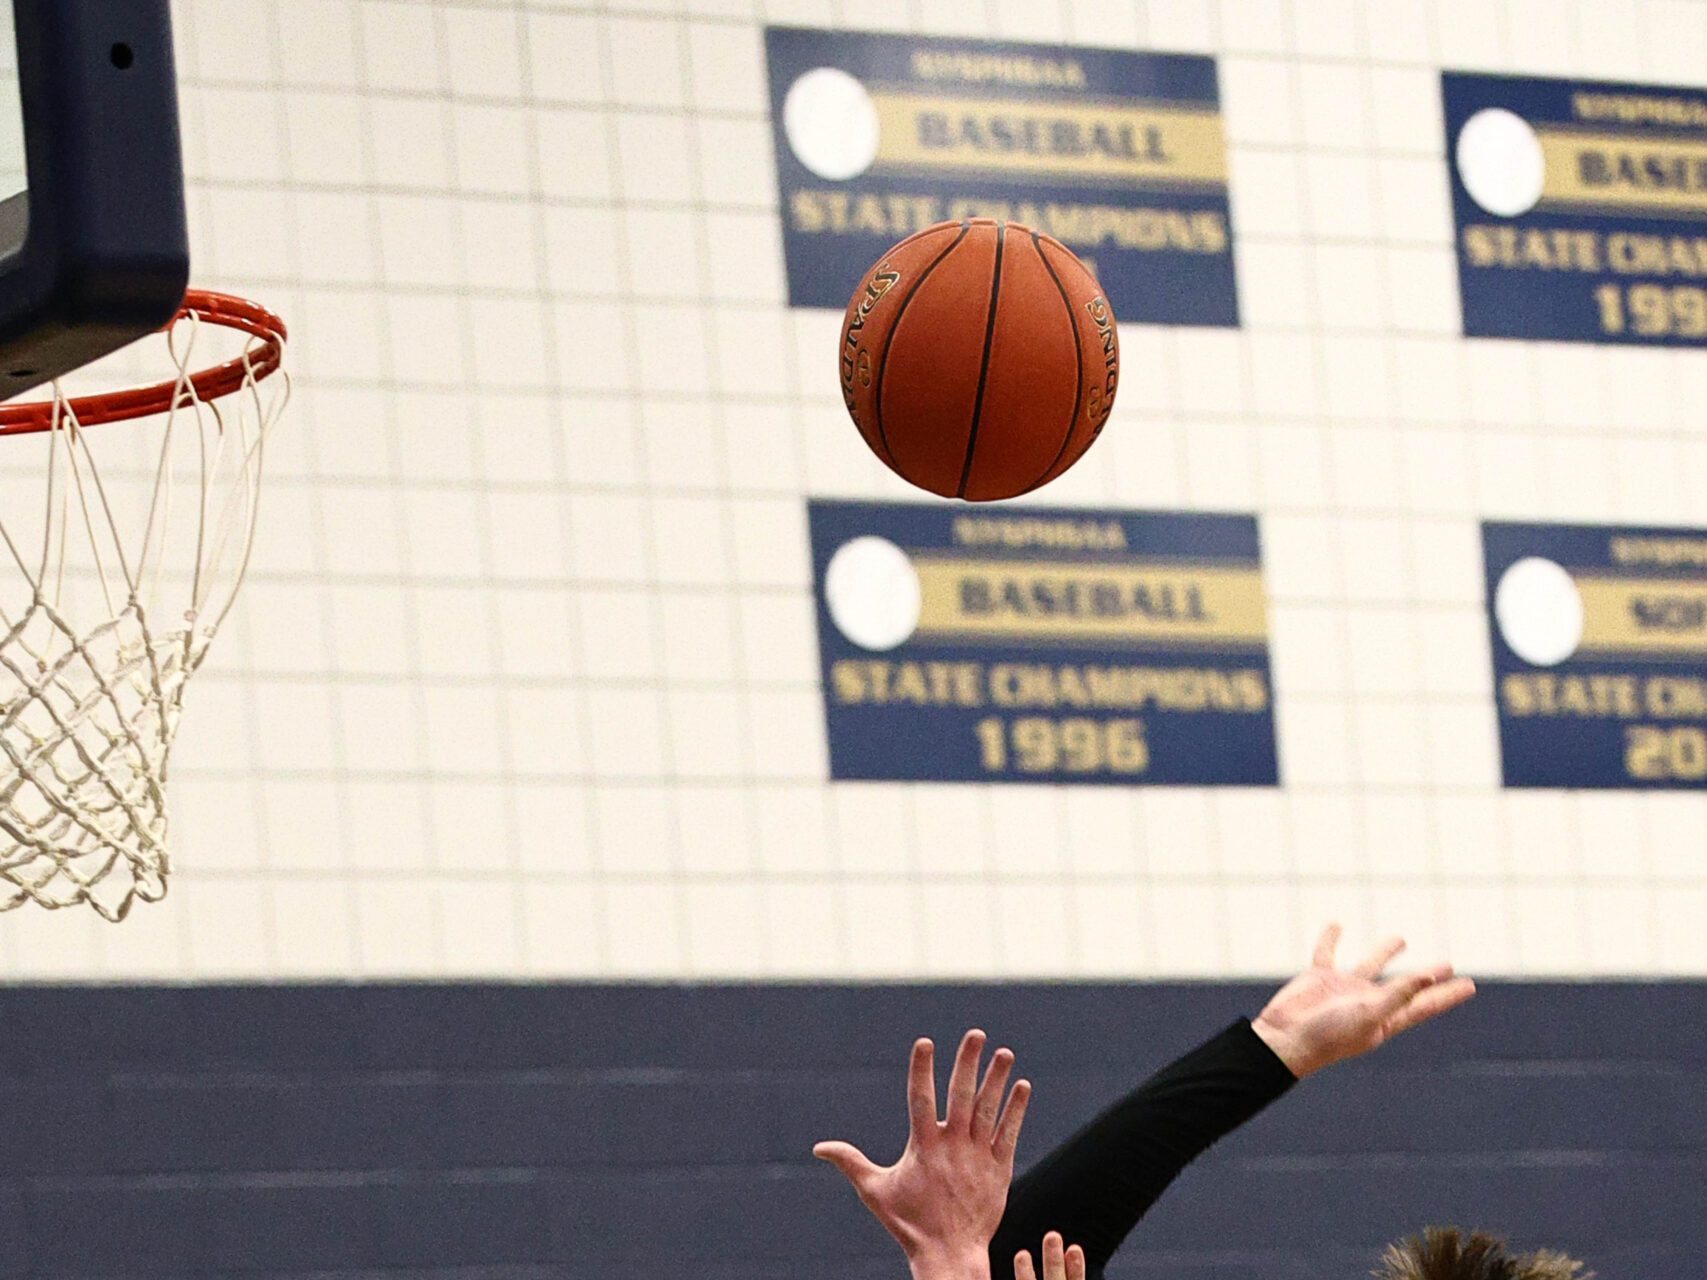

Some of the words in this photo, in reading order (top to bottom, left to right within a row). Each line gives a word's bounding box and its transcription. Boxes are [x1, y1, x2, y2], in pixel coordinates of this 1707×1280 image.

[916, 111, 1171, 162] BASEBALL
[1576, 149, 1707, 189] BASE
[792, 188, 940, 234] STATE
[1463, 223, 1601, 271] STATE
[956, 577, 1214, 621] BASEBALL
[830, 659, 982, 707] STATE
[988, 661, 1267, 713] CHAMPIONS
[1502, 672, 1640, 718] STATE
[974, 716, 1150, 773] 1996
